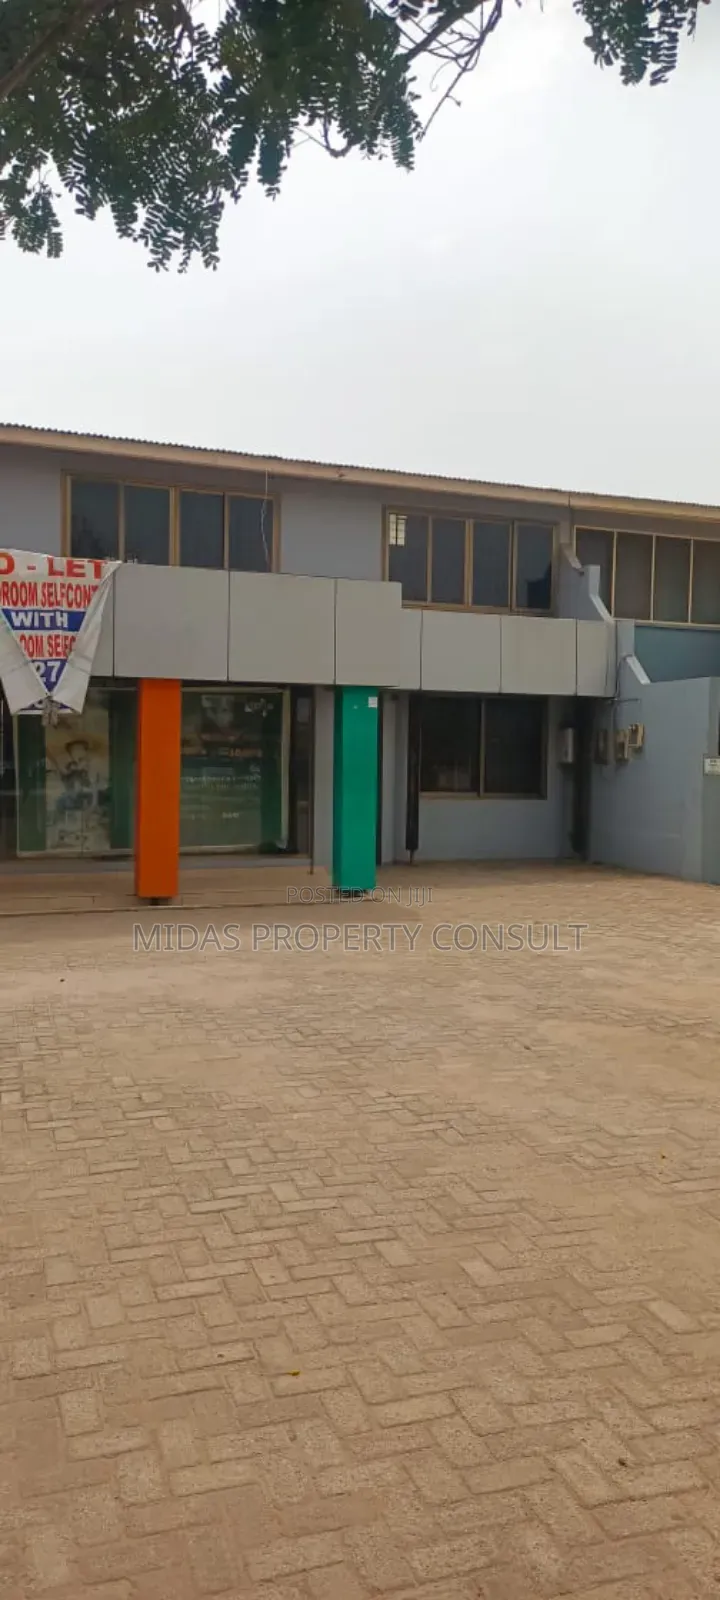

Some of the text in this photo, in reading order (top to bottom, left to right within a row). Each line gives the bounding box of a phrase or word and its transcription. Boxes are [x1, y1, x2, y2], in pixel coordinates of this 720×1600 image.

[47, 556, 107, 579] LET
[0, 581, 38, 607] ROOM
[11, 611, 68, 628] WITH
